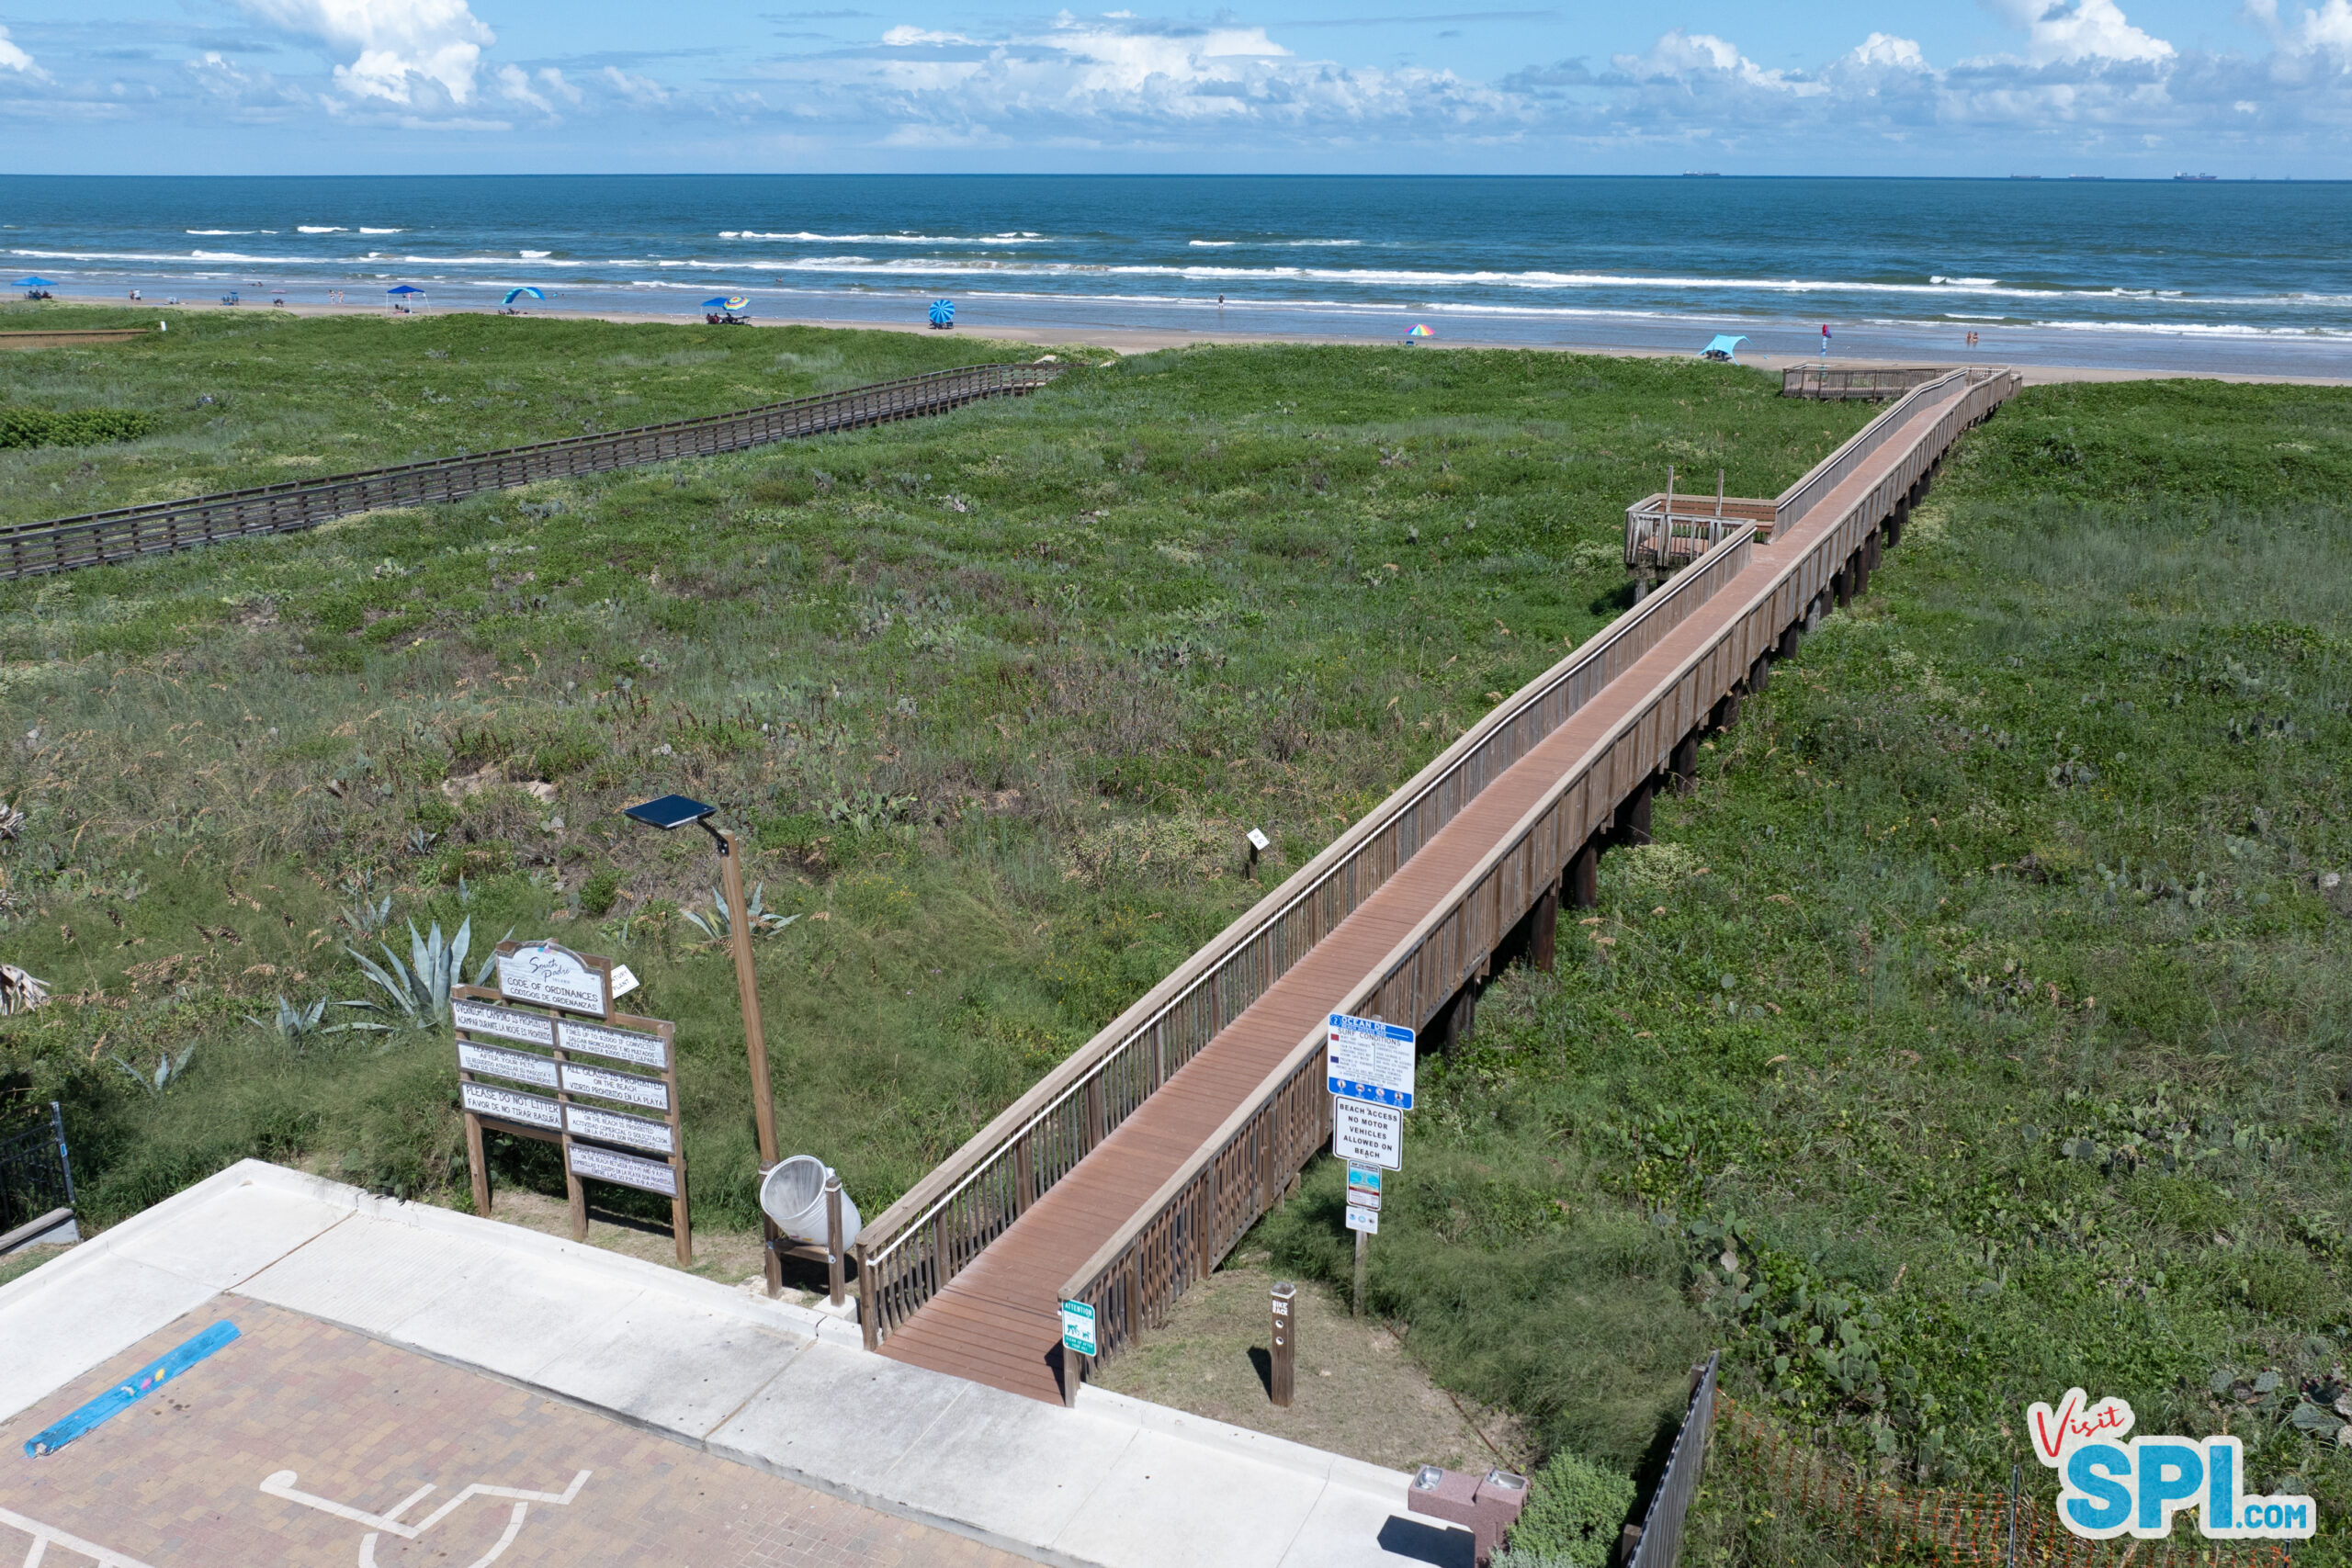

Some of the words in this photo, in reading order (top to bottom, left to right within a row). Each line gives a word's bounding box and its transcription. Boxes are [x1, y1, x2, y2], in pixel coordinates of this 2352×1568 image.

[529, 957, 558, 973] South
[542, 965, 571, 982] Padre
[507, 977, 528, 988] CODE
[545, 985, 598, 1002] ORDINANCES
[553, 996, 597, 1010] ORDENANZAS
[456, 1004, 484, 1016] OVERNIGHT
[486, 1009, 510, 1021] CAMPING
[519, 1016, 549, 1028] PROHIBITED
[1342, 1017, 1371, 1028] OCEAN
[479, 1020, 498, 1029] DURANTE
[506, 1025, 520, 1033] NOCHE
[1360, 1032, 1401, 1046] CONDITIONS
[583, 1069, 607, 1079] GLASS
[621, 1076, 662, 1089] PROHIBITED
[570, 1082, 590, 1092] VIDRIO
[592, 1086, 622, 1098] PROHIBIDO
[643, 1096, 663, 1106] PLAYA
[617, 1083, 636, 1091] BEACH
[466, 1086, 496, 1100] PLEASE
[500, 1093, 510, 1102] DO
[513, 1095, 528, 1106] NOT
[531, 1100, 558, 1113] LITTER
[468, 1098, 490, 1109] FAVOR
[512, 1107, 532, 1118] TIRAR
[533, 1111, 560, 1125] BASURA
[1340, 1104, 1365, 1114] BEACH
[1368, 1110, 1397, 1122] ACCESS
[1362, 1119, 1388, 1130] MOTOR
[1349, 1126, 1387, 1139] VEHICLES
[1343, 1135, 1379, 1148] ALLOWED
[1355, 1148, 1380, 1158] BEACH
[1065, 1303, 1092, 1316] ATTENTION
[1272, 1300, 1288, 1308] BIKE
[1272, 1306, 1288, 1316] RACK
